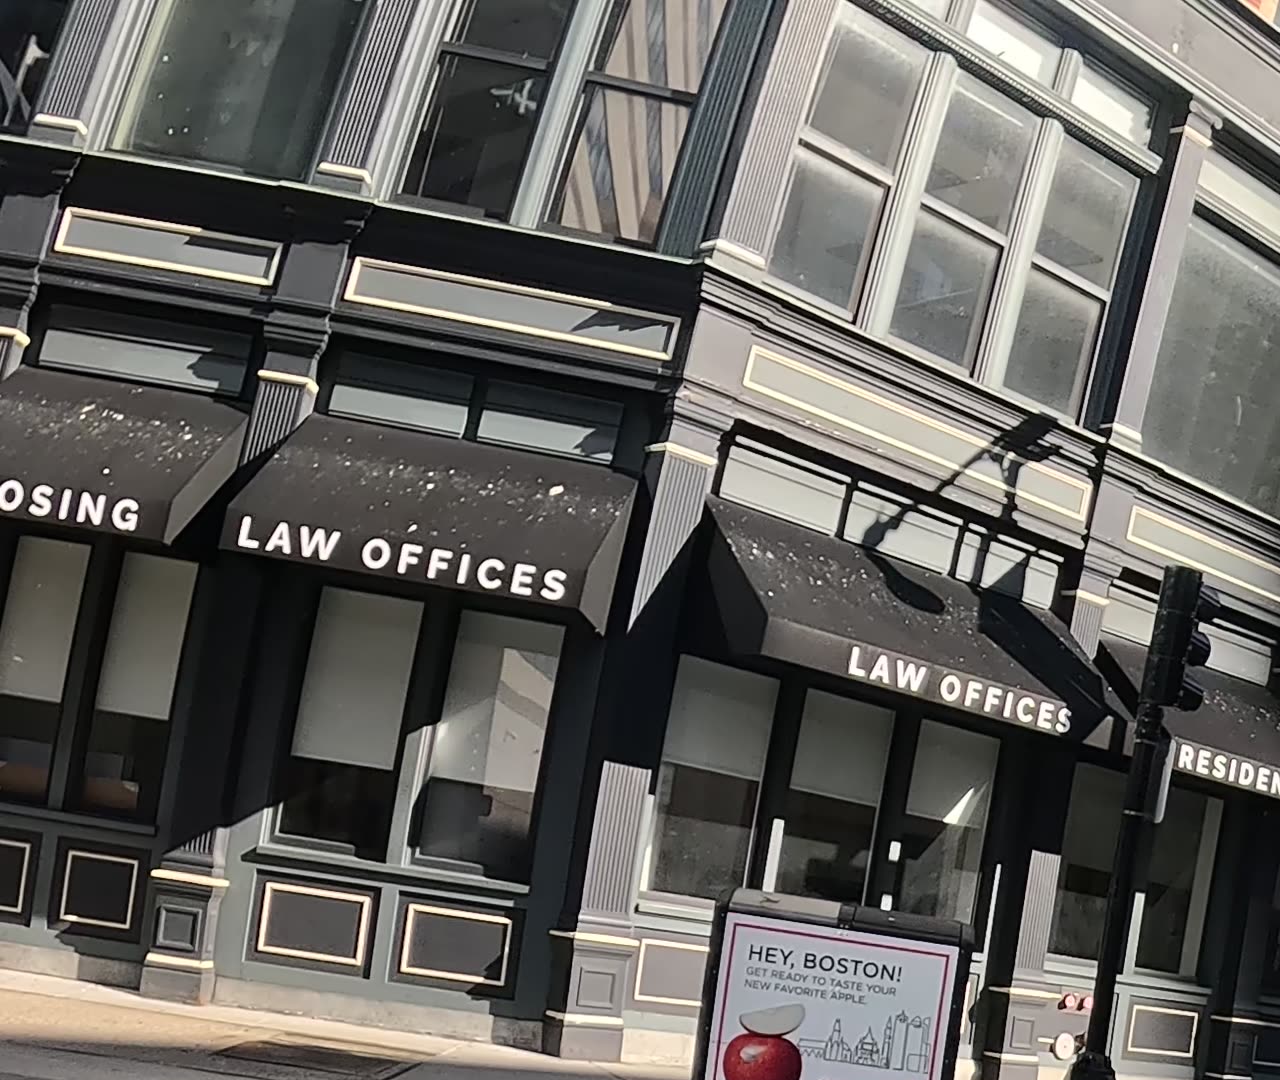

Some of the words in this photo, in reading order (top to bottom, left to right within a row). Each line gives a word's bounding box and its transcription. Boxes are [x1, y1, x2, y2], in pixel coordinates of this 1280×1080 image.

[0, 479, 140, 531] OSING
[237, 515, 342, 561] LAW
[361, 537, 568, 601] OFFICES
[848, 646, 927, 692] LAW
[939, 675, 1073, 734] OFFICES
[746, 966, 768, 978] GET
[771, 969, 808, 983] READY
[812, 975, 826, 986] TO
[830, 977, 863, 992] TASTE
[866, 983, 897, 996] YOUR
[748, 944, 795, 970] HEY,
[803, 952, 902, 983] BOSTON!
[744, 978, 772, 990] NEW
[774, 982, 827, 1000] FAVORITE
